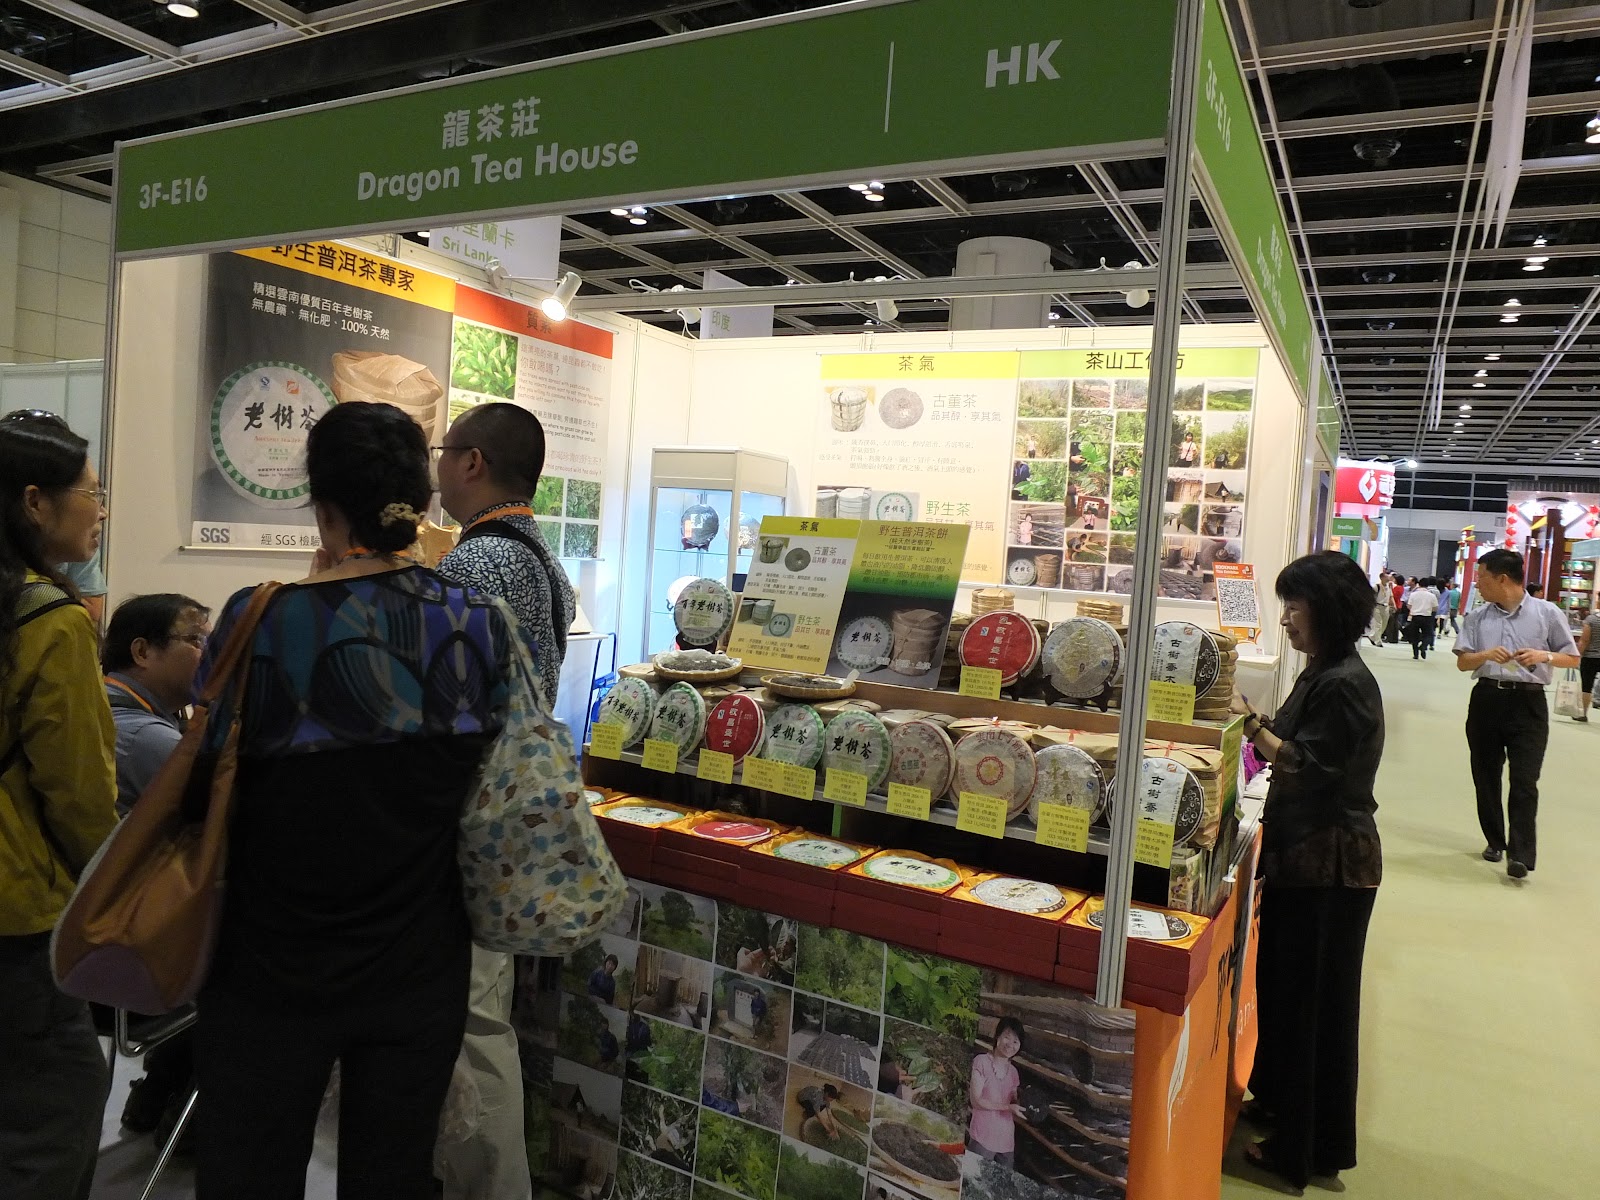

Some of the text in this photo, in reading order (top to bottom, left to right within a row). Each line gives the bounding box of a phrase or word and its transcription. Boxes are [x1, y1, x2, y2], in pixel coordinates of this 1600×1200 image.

[986, 39, 1063, 88] HK
[441, 97, 541, 150] 龍茶莊
[357, 138, 639, 202] Dragon Tea House
[139, 176, 208, 210] 3F-E16
[442, 236, 500, 266] Sri Lanka
[271, 243, 415, 293] 野生普洱茶專家
[253, 281, 373, 322] 精選雲南優質百年老樹茶
[370, 326, 390, 341] 天然
[898, 356, 935, 372] 茶氣
[932, 394, 978, 409] 古董茶
[244, 401, 320, 431] 老樹茶
[926, 501, 971, 517] 野生茶
[200, 527, 230, 544] SGS
[261, 533, 320, 547] 經 SGS 檢驗
[878, 524, 949, 539] 野生普洱茶餅
[681, 598, 724, 614] 百年老樹茶
[797, 615, 822, 626] 野生茶
[850, 631, 883, 644] 老樹茶
[608, 695, 639, 723] 百年老樹茶
[656, 704, 687, 729] 老樹茶
[769, 723, 808, 746] 老樹茶
[831, 735, 872, 760] 老樹茶
